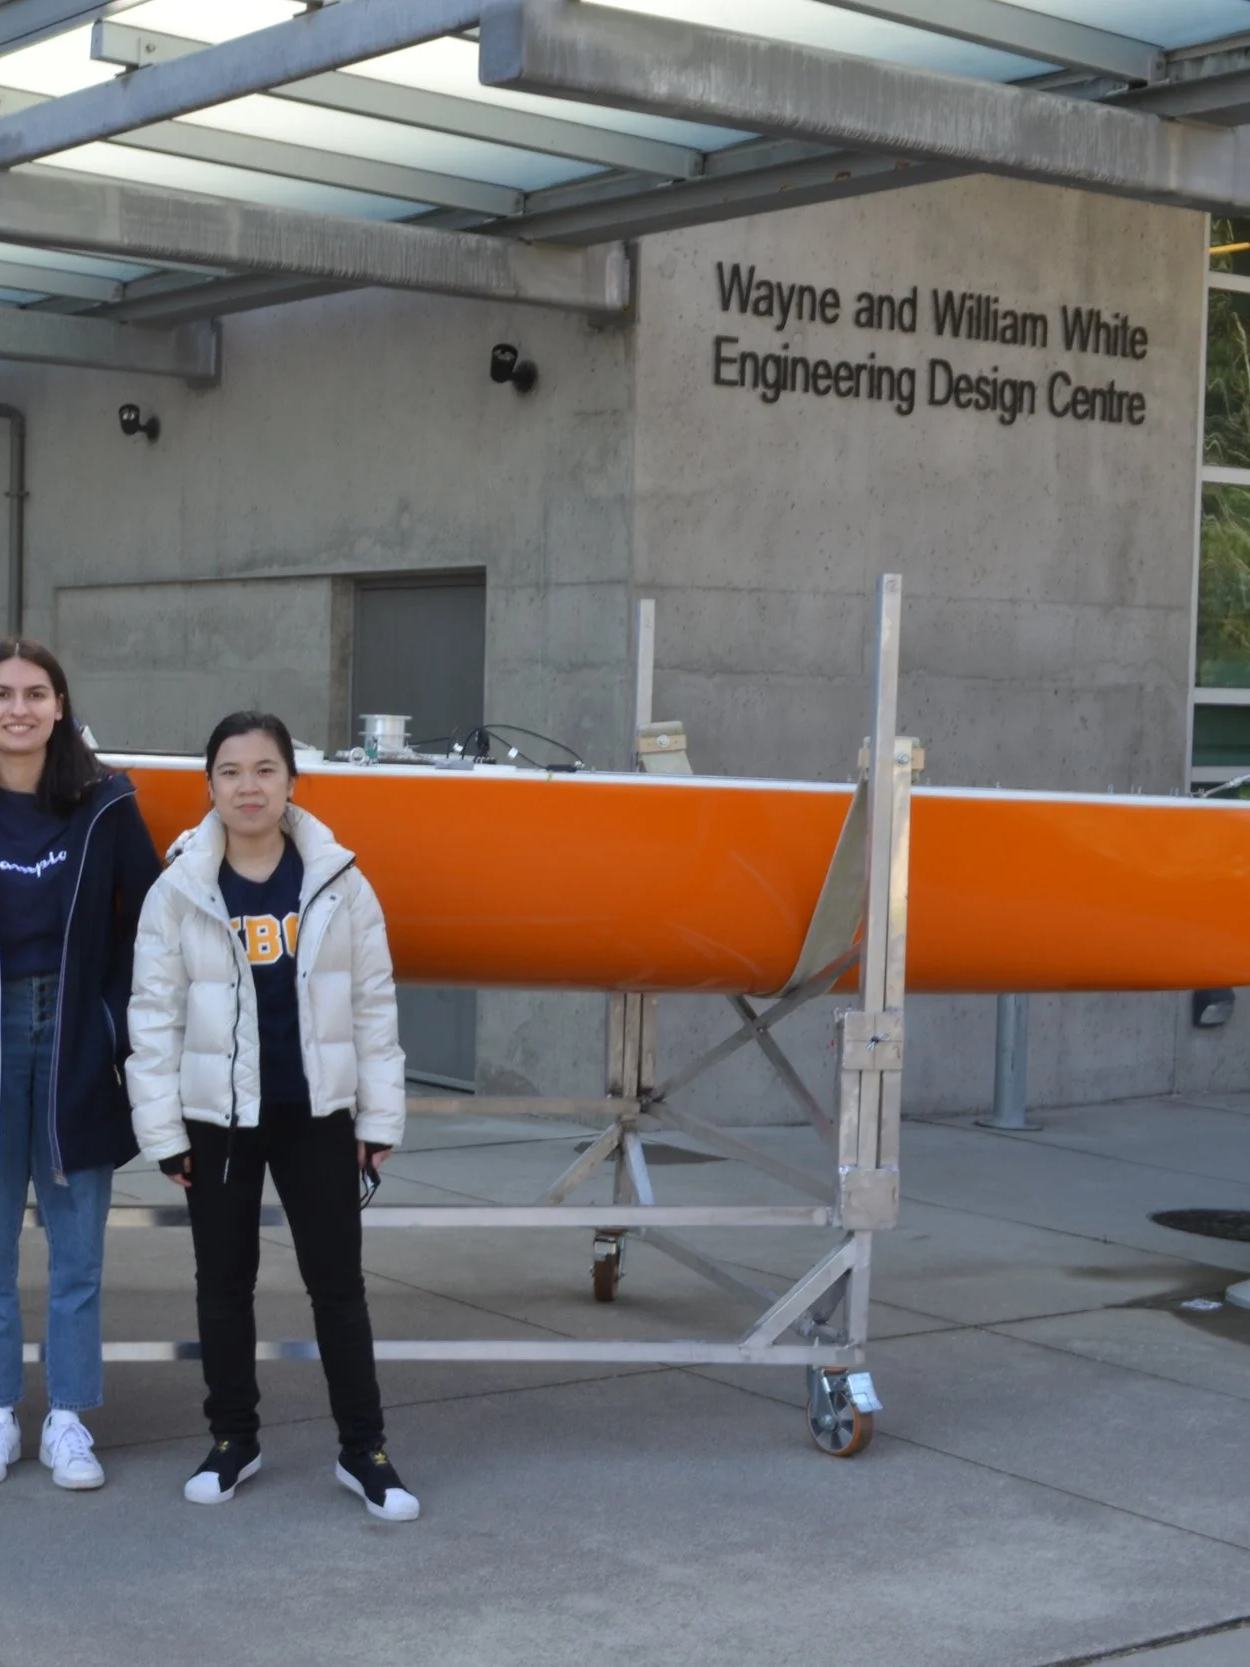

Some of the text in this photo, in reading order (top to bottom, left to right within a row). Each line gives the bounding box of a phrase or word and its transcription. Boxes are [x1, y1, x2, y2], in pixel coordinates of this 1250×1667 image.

[716, 261, 1149, 360] Wayne and William White
[713, 335, 1146, 425] Engineering Design Centre
